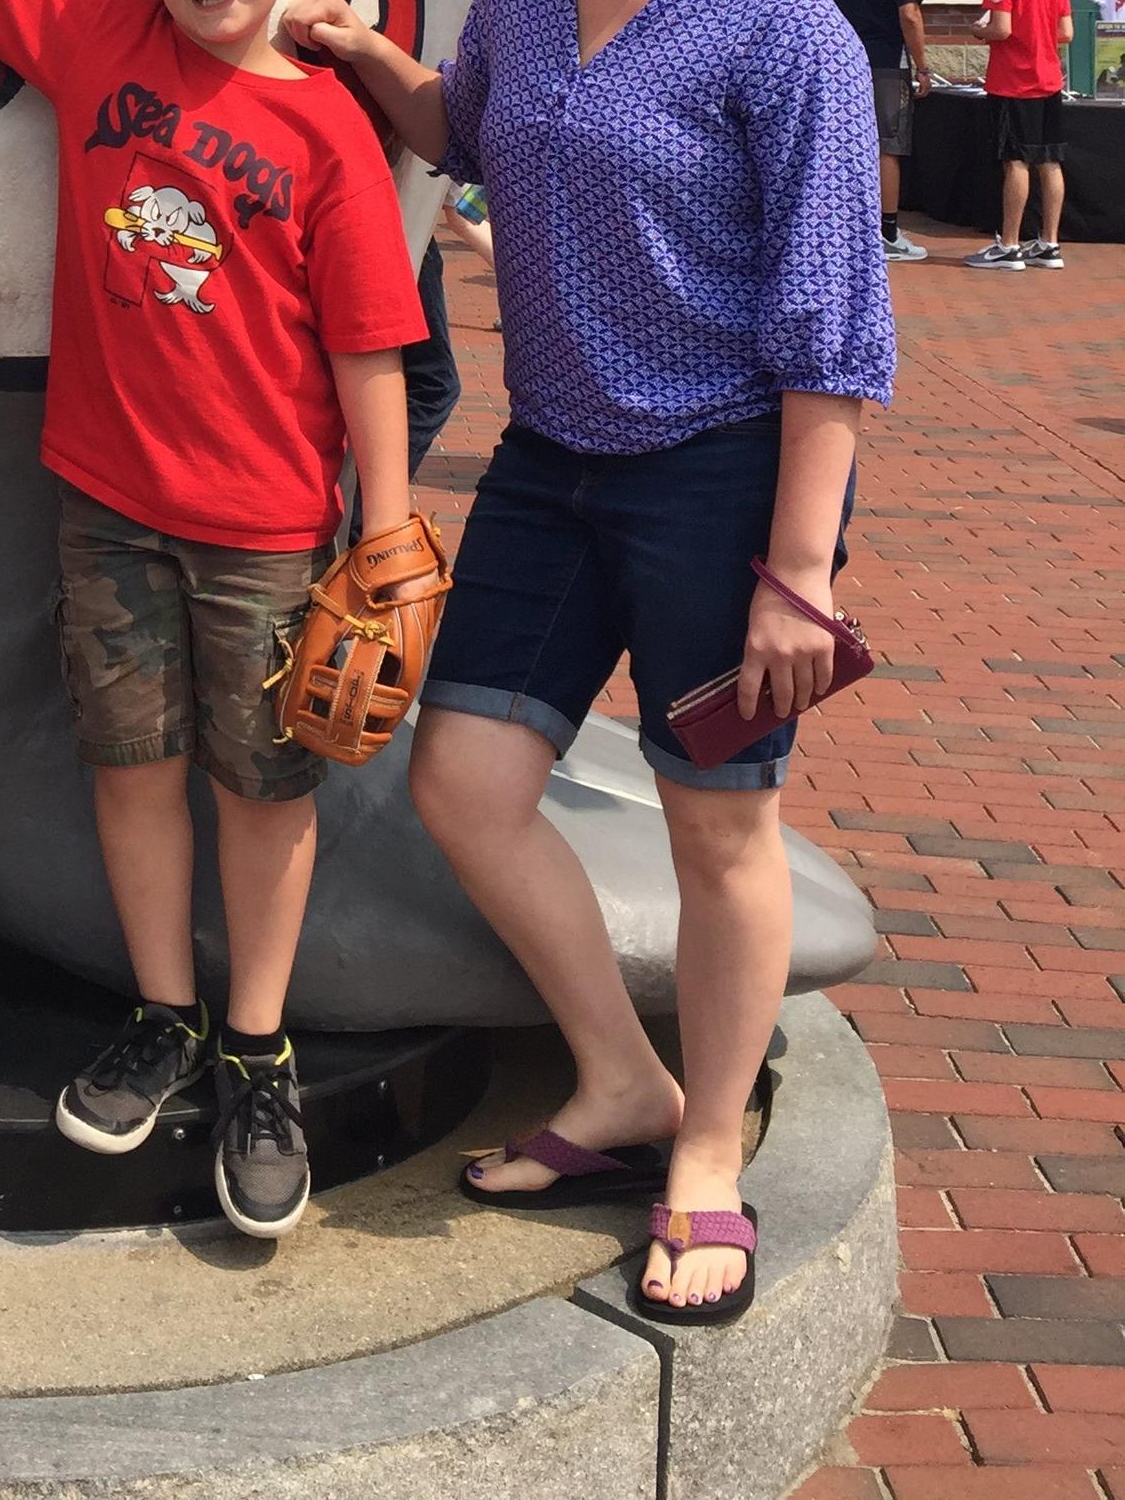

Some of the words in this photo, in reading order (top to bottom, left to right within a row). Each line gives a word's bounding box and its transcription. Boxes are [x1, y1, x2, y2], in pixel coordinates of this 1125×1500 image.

[85, 82, 181, 154] Sea
[183, 121, 294, 230] Dogs
[366, 537, 425, 569] SPALDING
